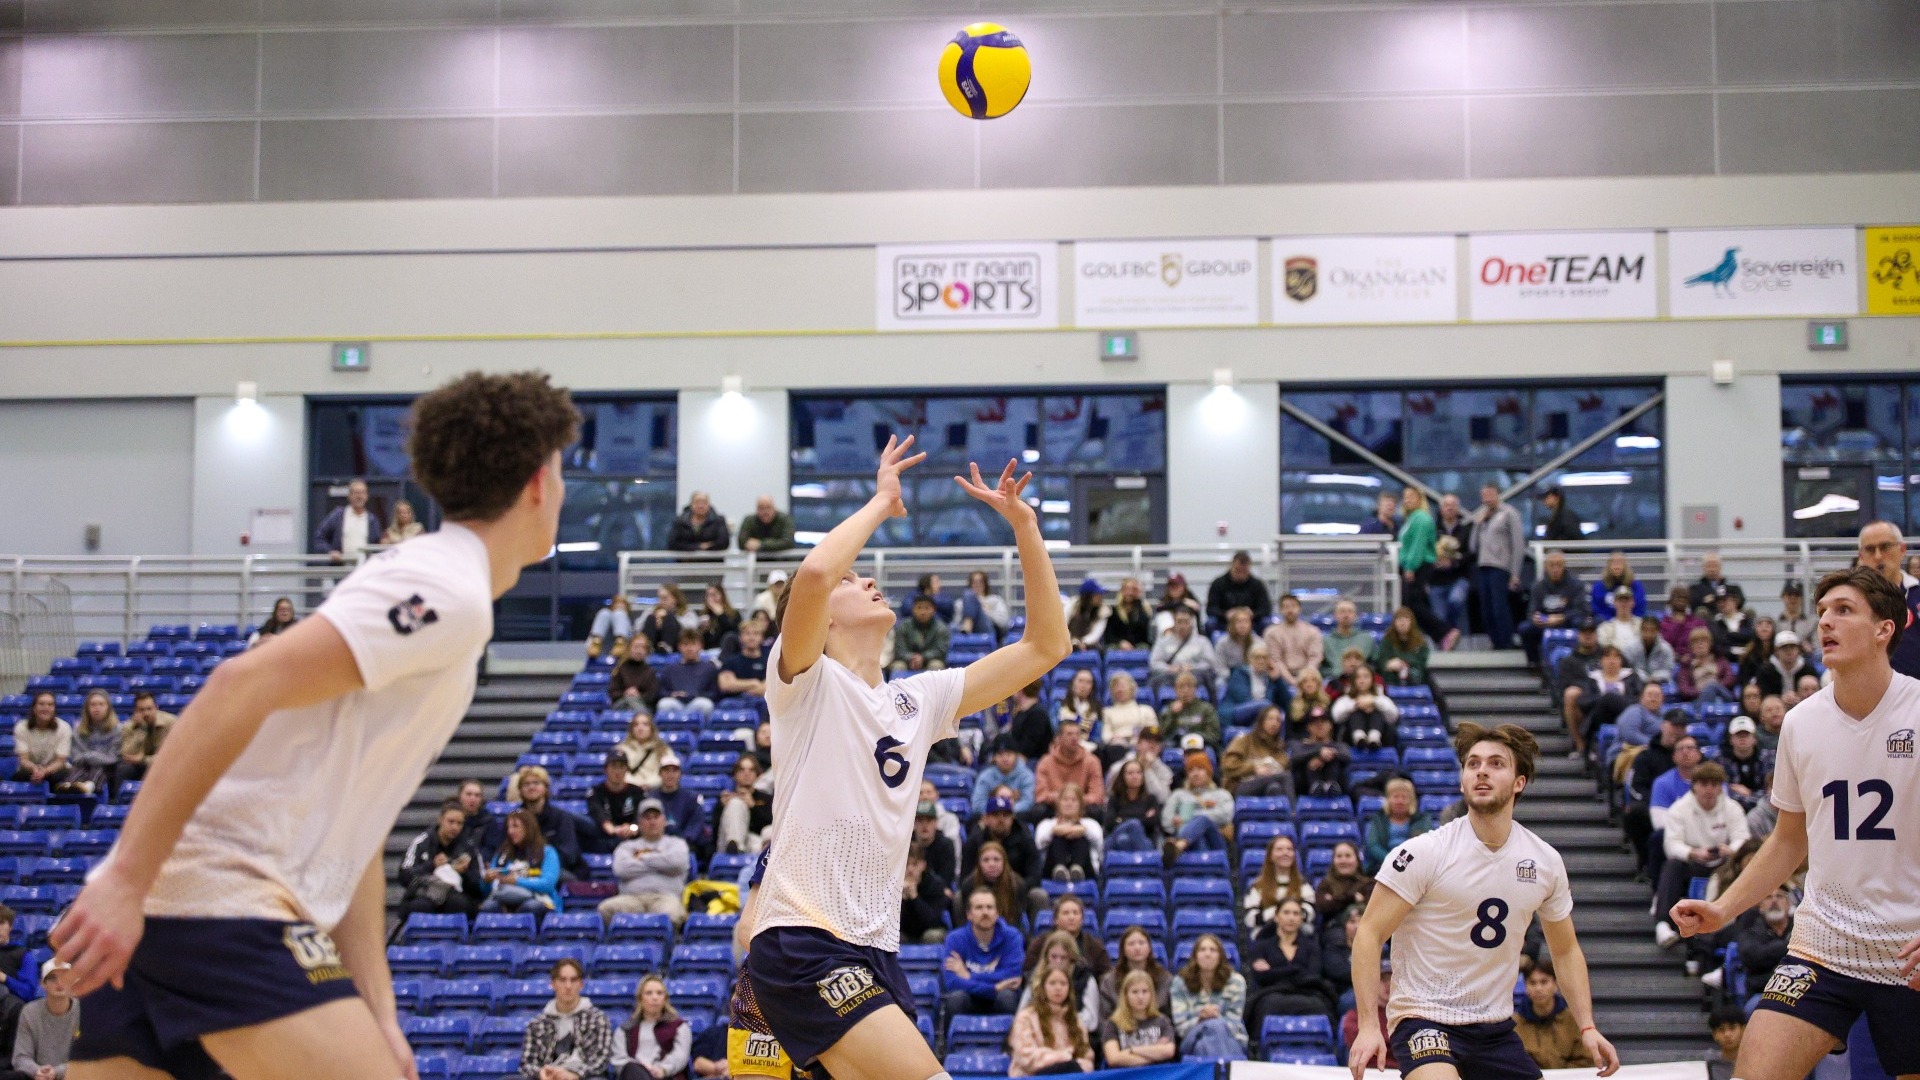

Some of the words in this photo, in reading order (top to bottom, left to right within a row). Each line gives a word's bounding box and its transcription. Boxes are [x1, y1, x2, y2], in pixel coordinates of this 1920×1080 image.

[901, 262, 946, 279] PLAY
[953, 262, 968, 277] IT
[973, 261, 1033, 277] AGAIN
[1081, 260, 1157, 280] GOLFBC
[1185, 259, 1252, 277] GROUP
[1329, 265, 1448, 288] OKANAGAN
[1481, 254, 1645, 286] OneTEAM
[1740, 256, 1845, 279] Sovereign
[901, 279, 1034, 312] SPORTS
[1887, 740, 1914, 753] UBC
[874, 735, 910, 788] 6
[1822, 779, 1896, 840] 12
[1516, 867, 1536, 879] UBC
[1470, 897, 1509, 948] 8
[836, 986, 885, 1017] VOLLEYBALL
[745, 1039, 780, 1060] UBC
[1411, 1049, 1451, 1060] VOLLEYBALL
